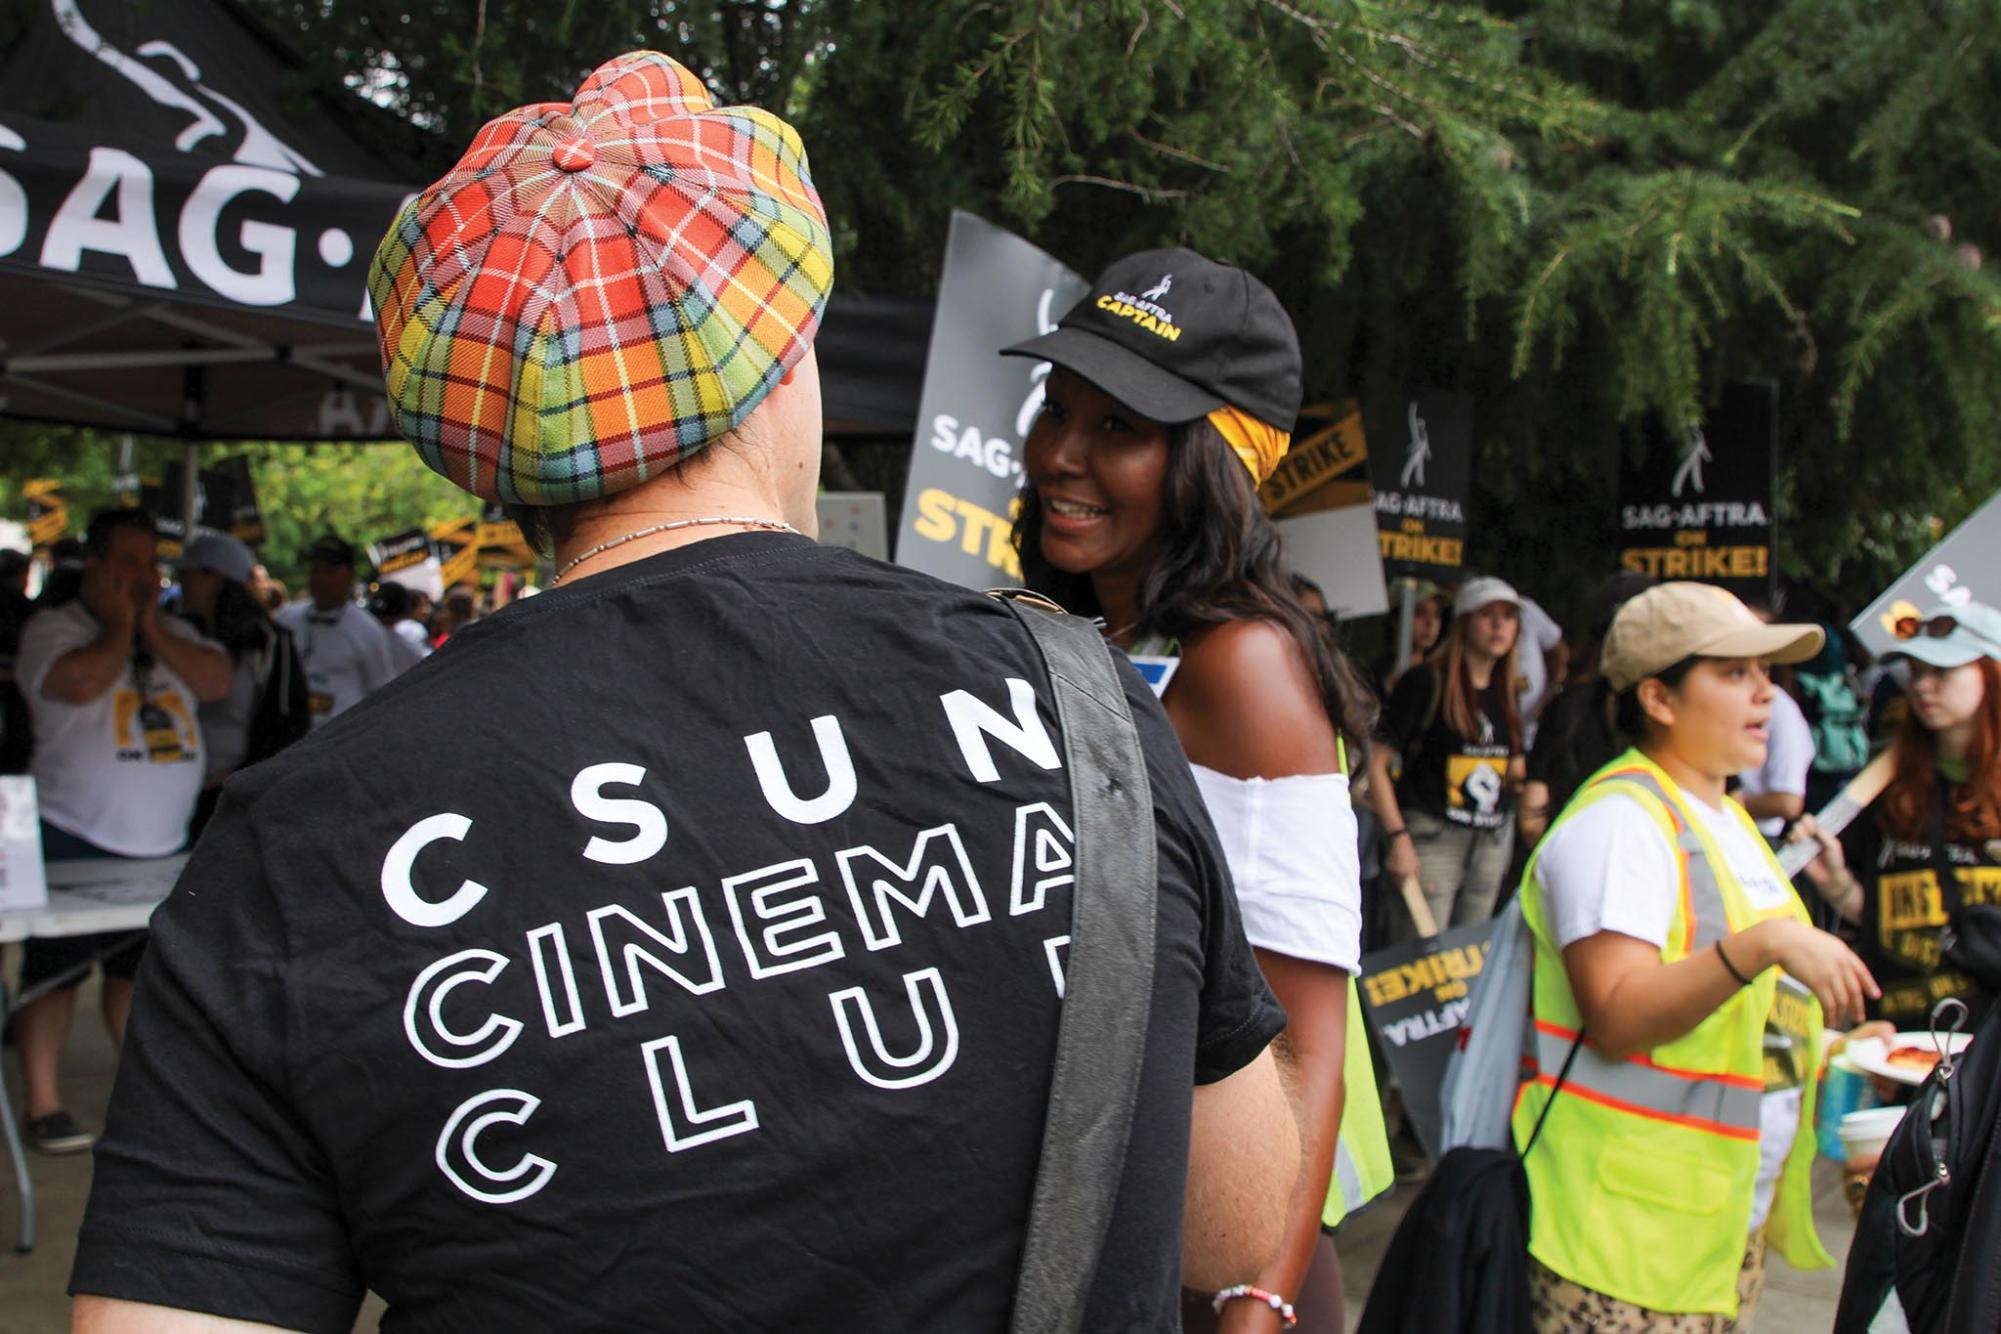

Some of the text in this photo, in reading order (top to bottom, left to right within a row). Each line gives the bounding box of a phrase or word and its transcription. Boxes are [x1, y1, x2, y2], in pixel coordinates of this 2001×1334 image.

[1097, 295, 1181, 341] CAPTAIN
[1266, 430, 1355, 499] STRIKE
[1402, 519, 1425, 533] ON
[1379, 530, 1463, 566] TRIKE!
[1621, 546, 1769, 577] STRIKE!
